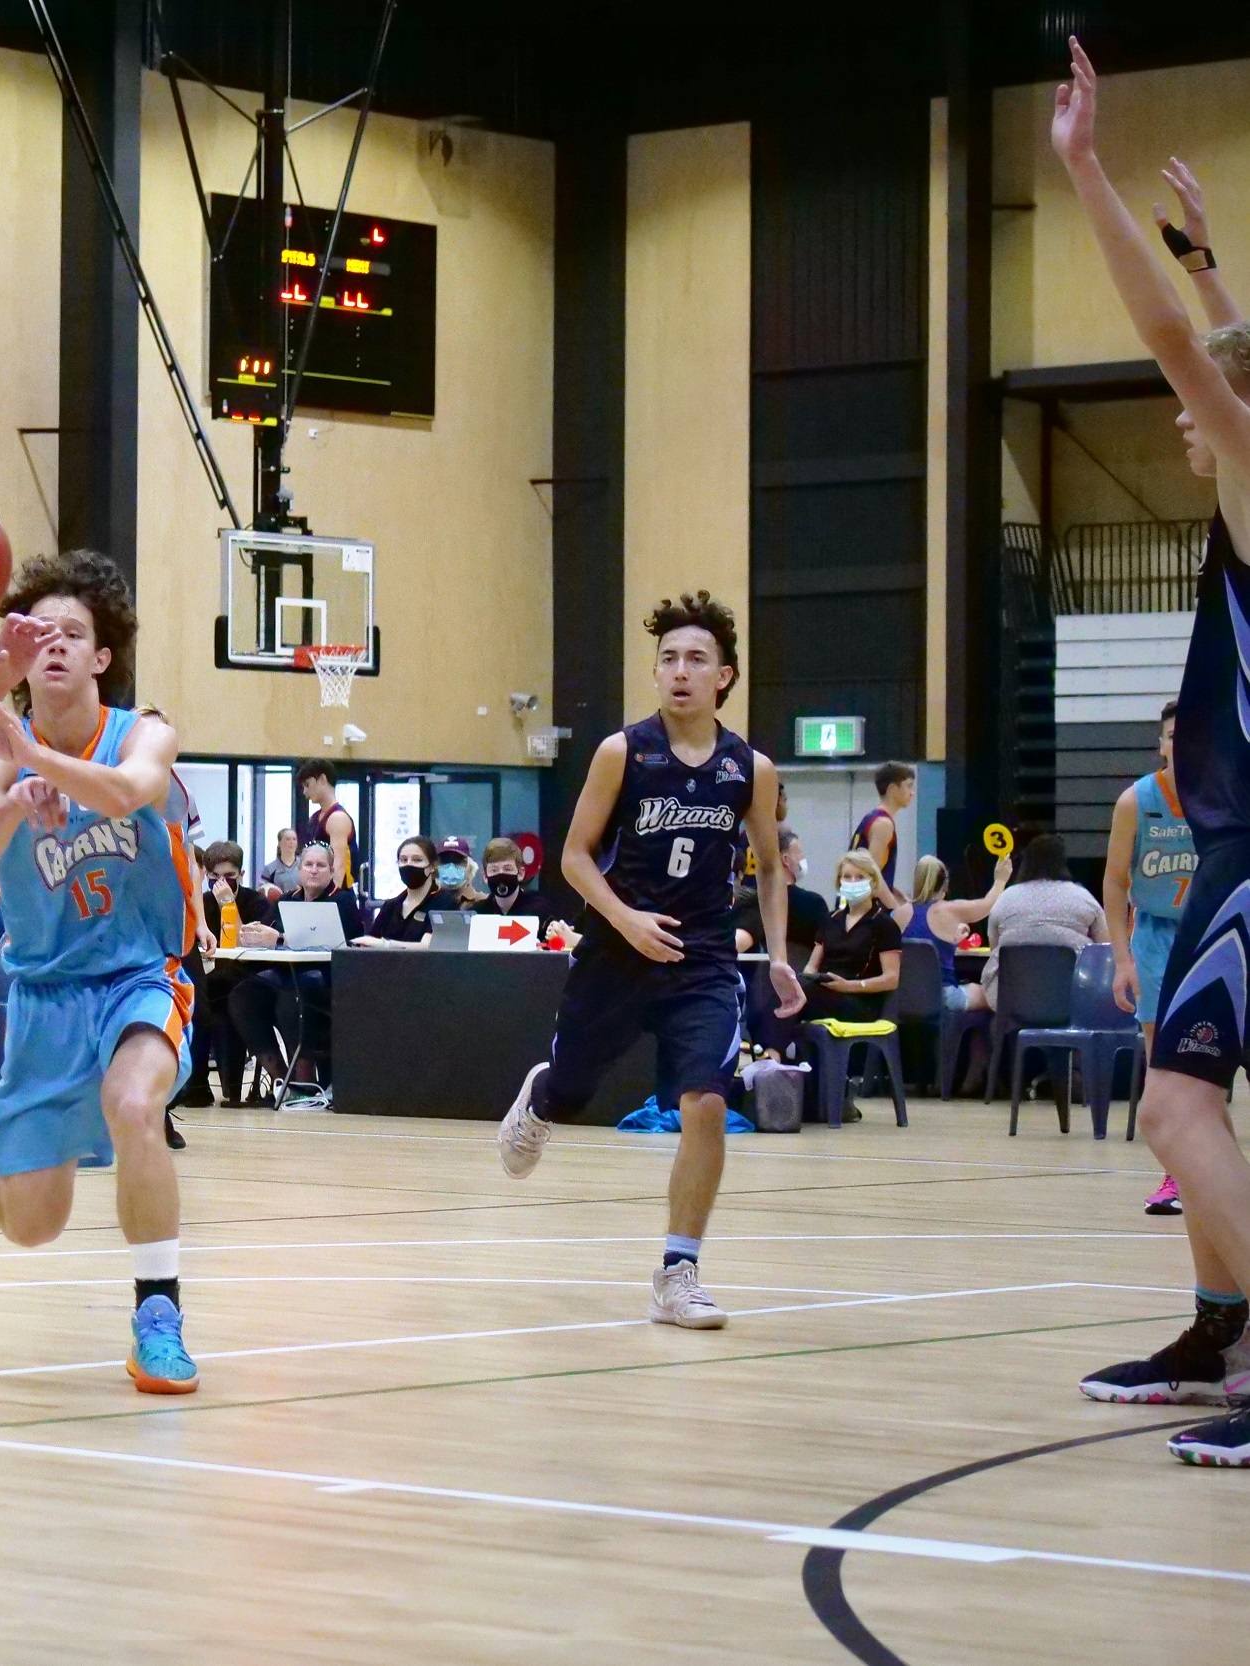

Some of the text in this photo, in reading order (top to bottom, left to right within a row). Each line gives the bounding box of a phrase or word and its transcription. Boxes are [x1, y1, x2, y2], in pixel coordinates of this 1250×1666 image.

[635, 796, 735, 836] Wizards
[34, 816, 140, 891] CAIRNS
[667, 836, 695, 878] 6
[990, 831, 1007, 849] 3
[70, 868, 113, 921] 15
[1172, 876, 1192, 908] 7
